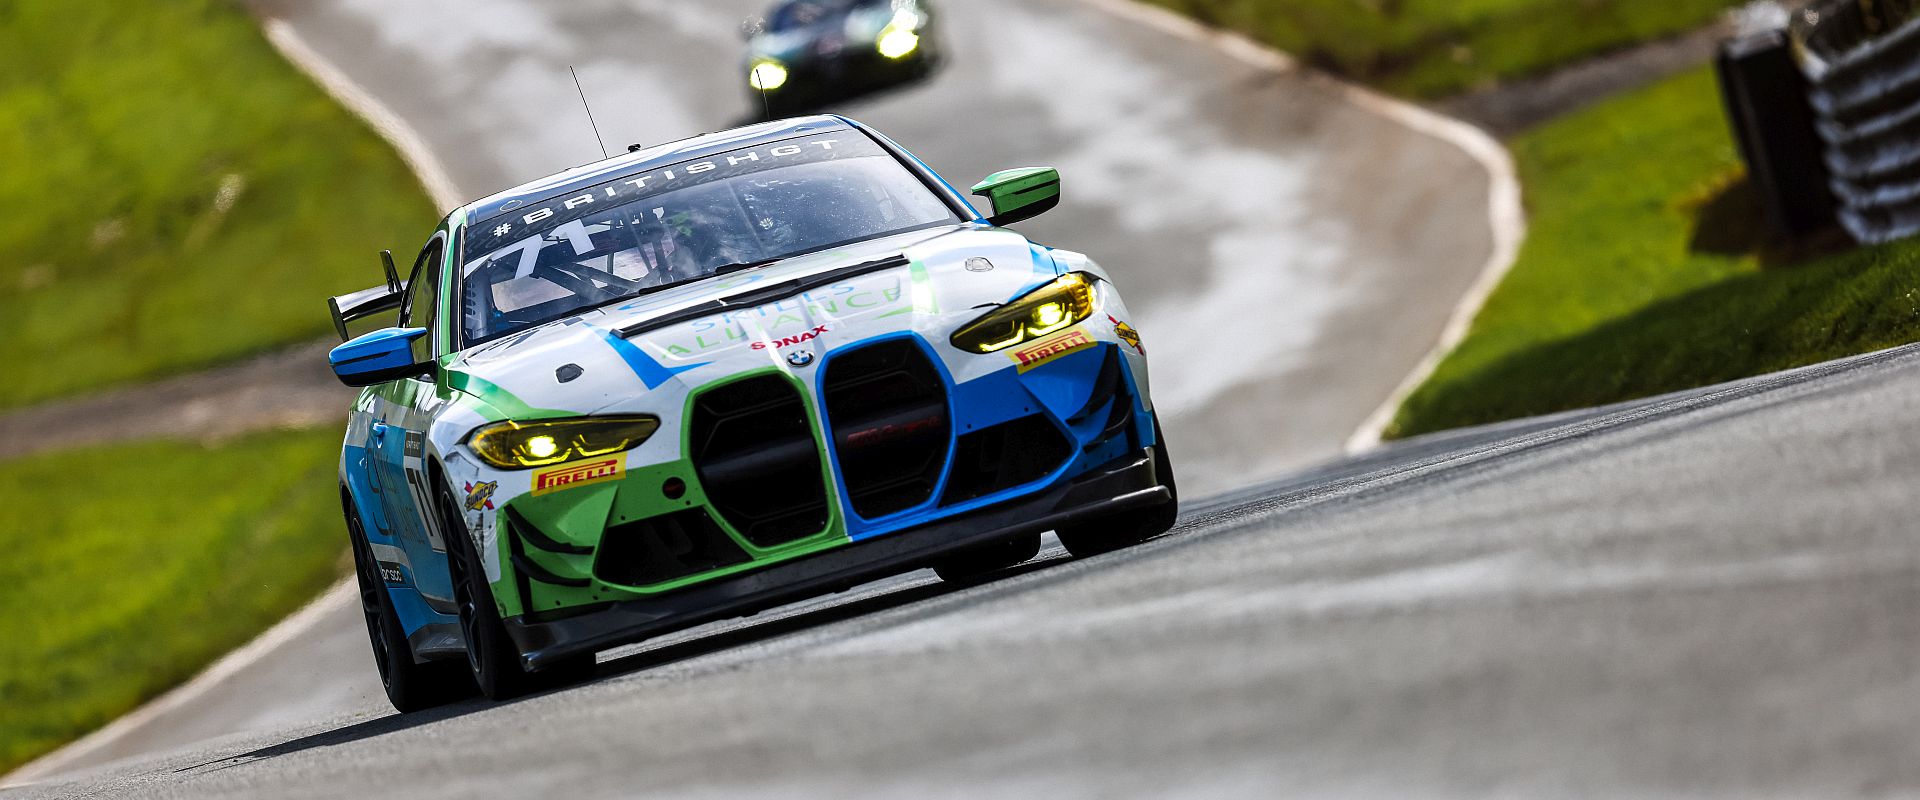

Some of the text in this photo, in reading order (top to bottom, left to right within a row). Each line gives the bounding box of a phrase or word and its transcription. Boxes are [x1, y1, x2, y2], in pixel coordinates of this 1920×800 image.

[662, 287, 900, 359] ALLIANCE
[751, 325, 828, 350] SONAX
[1015, 331, 1089, 366] PIRELLI
[537, 459, 618, 490] PIRELLI
[466, 482, 497, 509] SUNOCO
